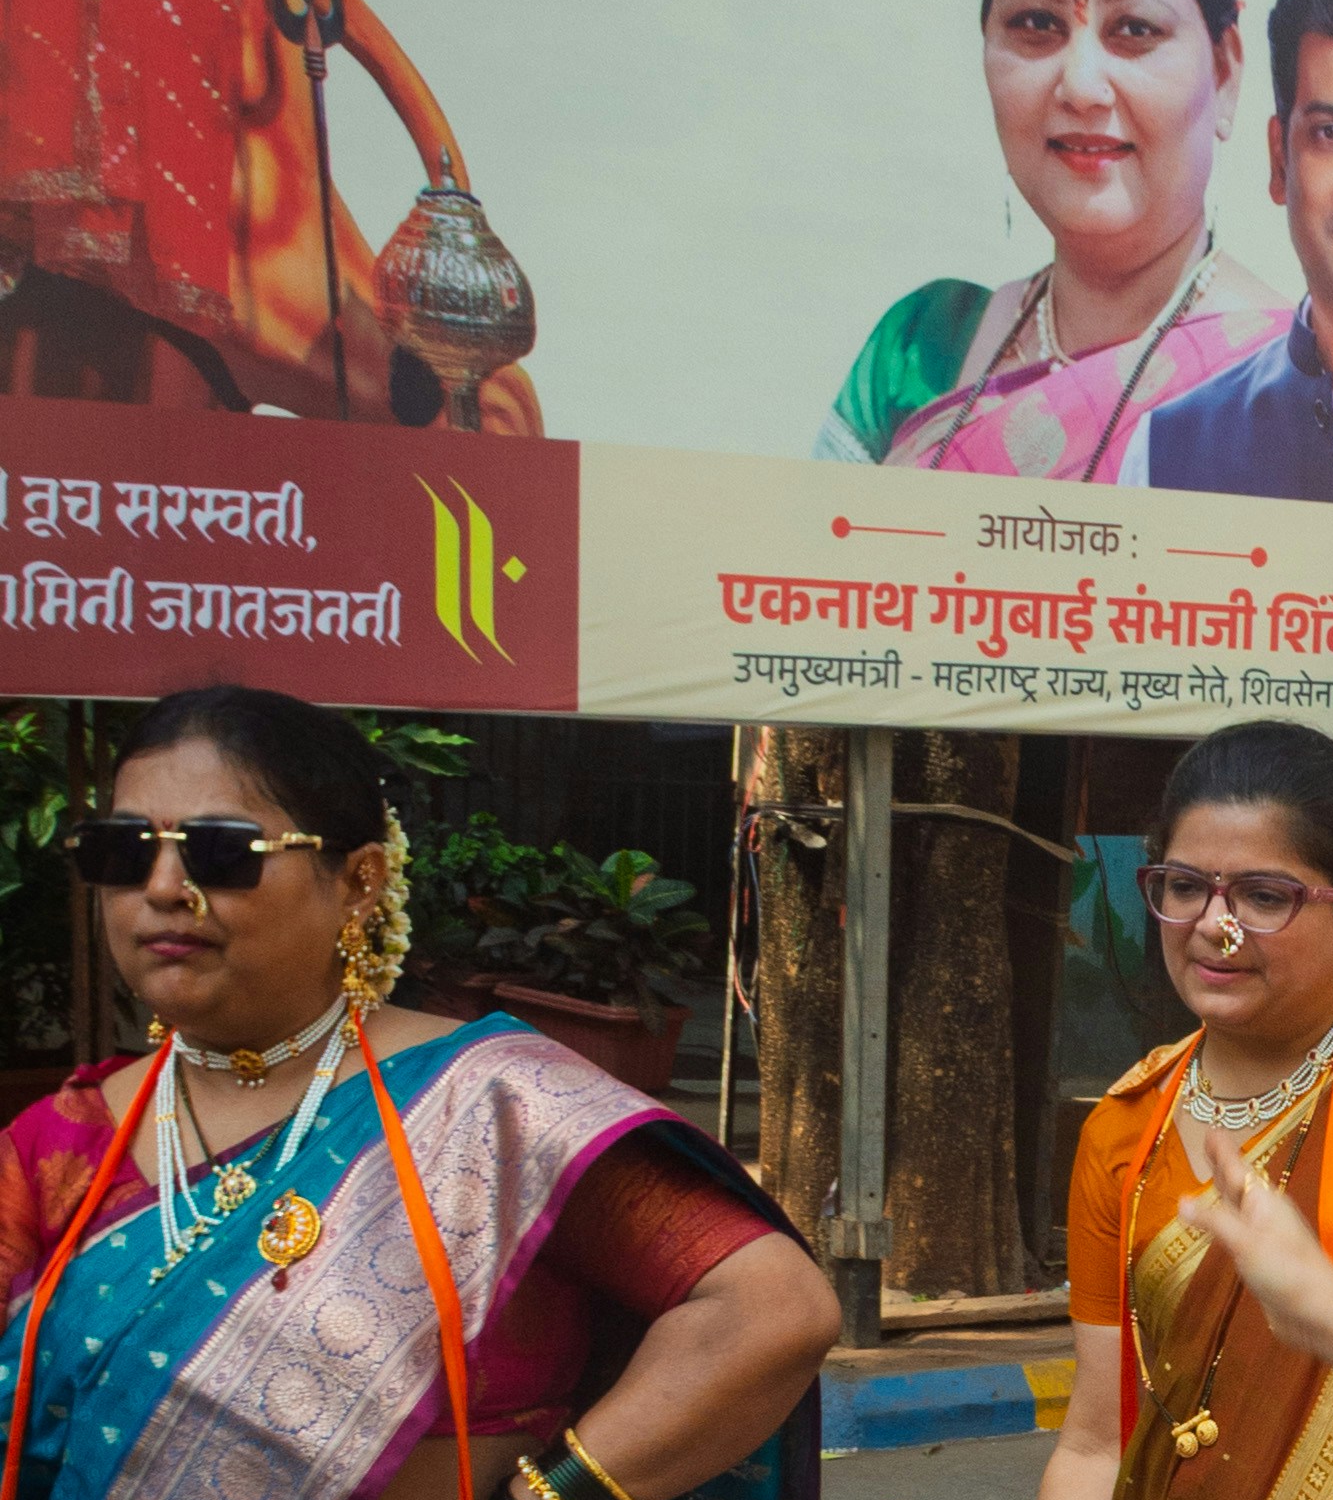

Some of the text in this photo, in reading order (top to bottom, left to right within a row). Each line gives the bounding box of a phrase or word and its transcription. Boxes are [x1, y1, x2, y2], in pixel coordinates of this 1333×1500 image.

[20, 476, 102, 540] तूच
[113, 481, 317, 553] सरस्वती,
[977, 505, 1122, 558] आयोजक
[144, 581, 402, 646] जगतजननी
[717, 573, 919, 632] एकनाथ
[928, 571, 1098, 658] गंगुबाई
[1105, 583, 1259, 651] संभाजी
[732, 648, 903, 698] उपमुख्यमंत्री
[931, 661, 1040, 703] महाराष्ट्र
[1046, 667, 1112, 703] राज्य,
[1120, 670, 1184, 711] मुख्य
[1187, 663, 1233, 708] नेते,
